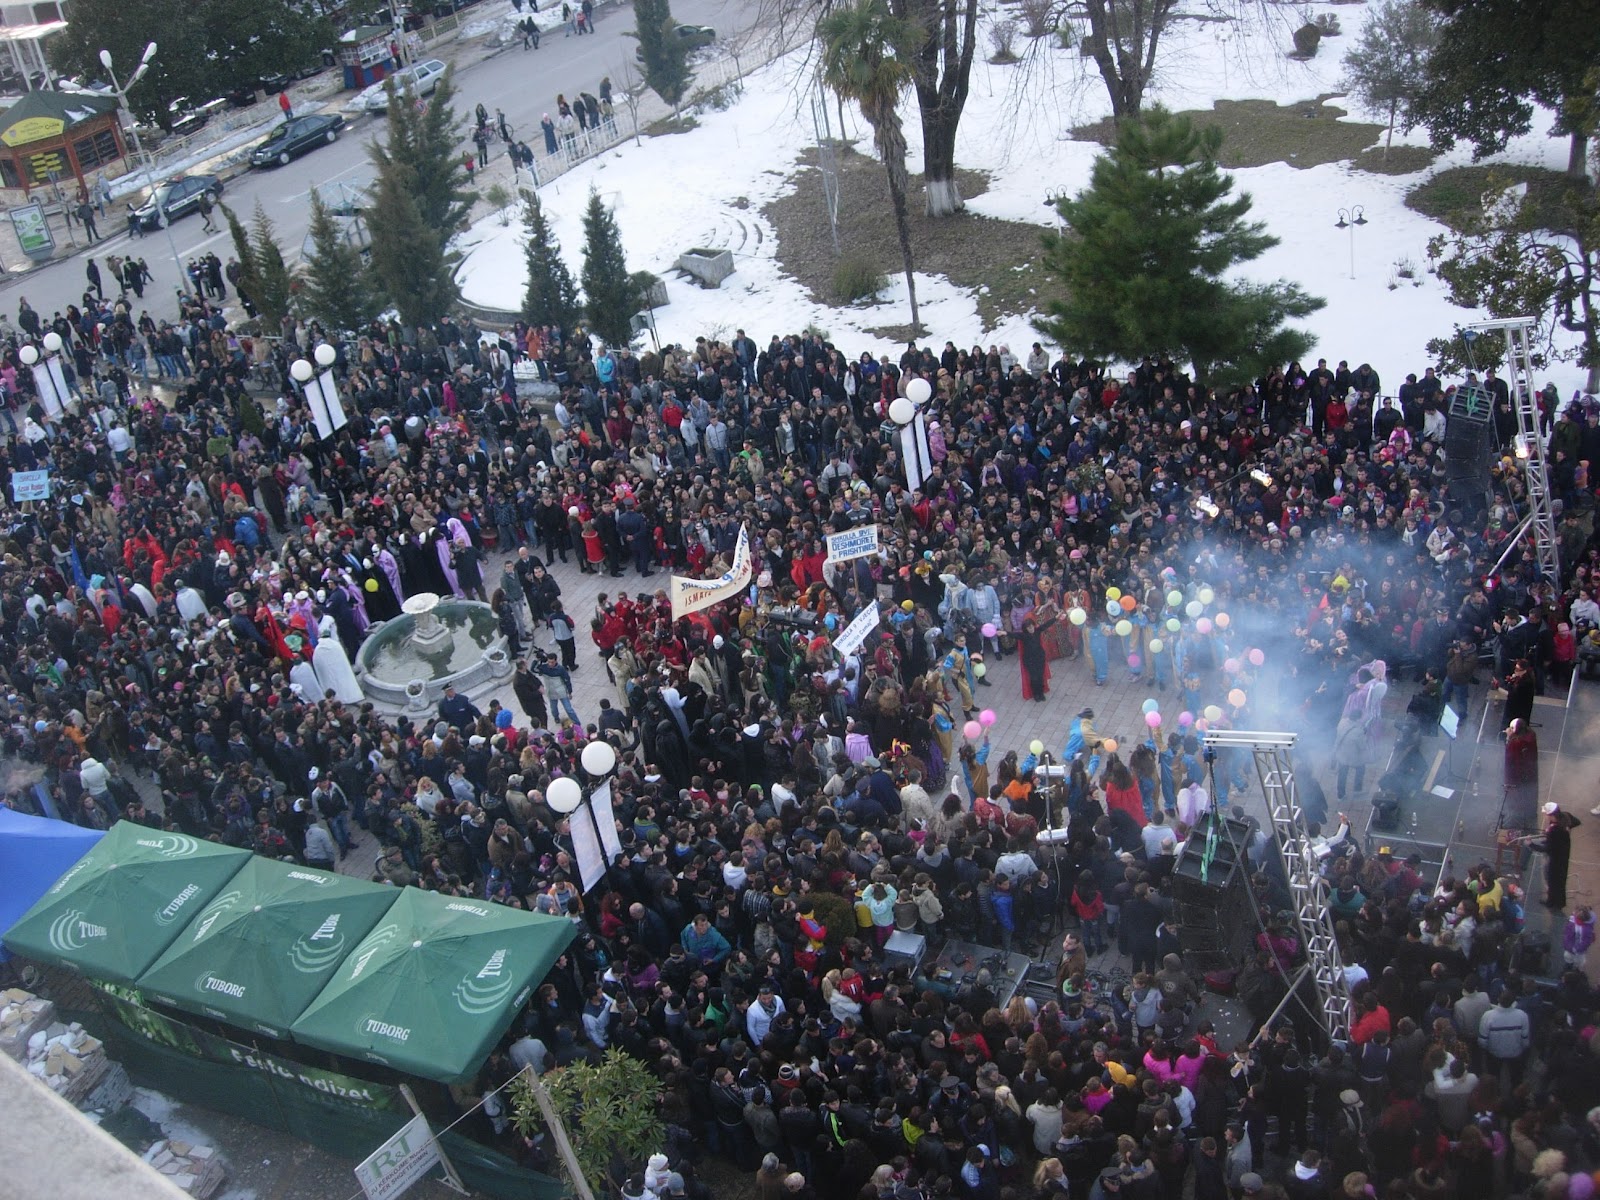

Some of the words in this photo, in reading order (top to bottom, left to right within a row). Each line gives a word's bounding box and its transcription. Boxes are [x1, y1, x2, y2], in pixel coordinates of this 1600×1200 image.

[835, 628, 853, 648] SHKOLLA
[162, 883, 199, 917] TUBORG
[446, 902, 489, 917] TUBORG
[205, 977, 246, 998] TUBORG
[365, 1019, 411, 1041] TUBORG
